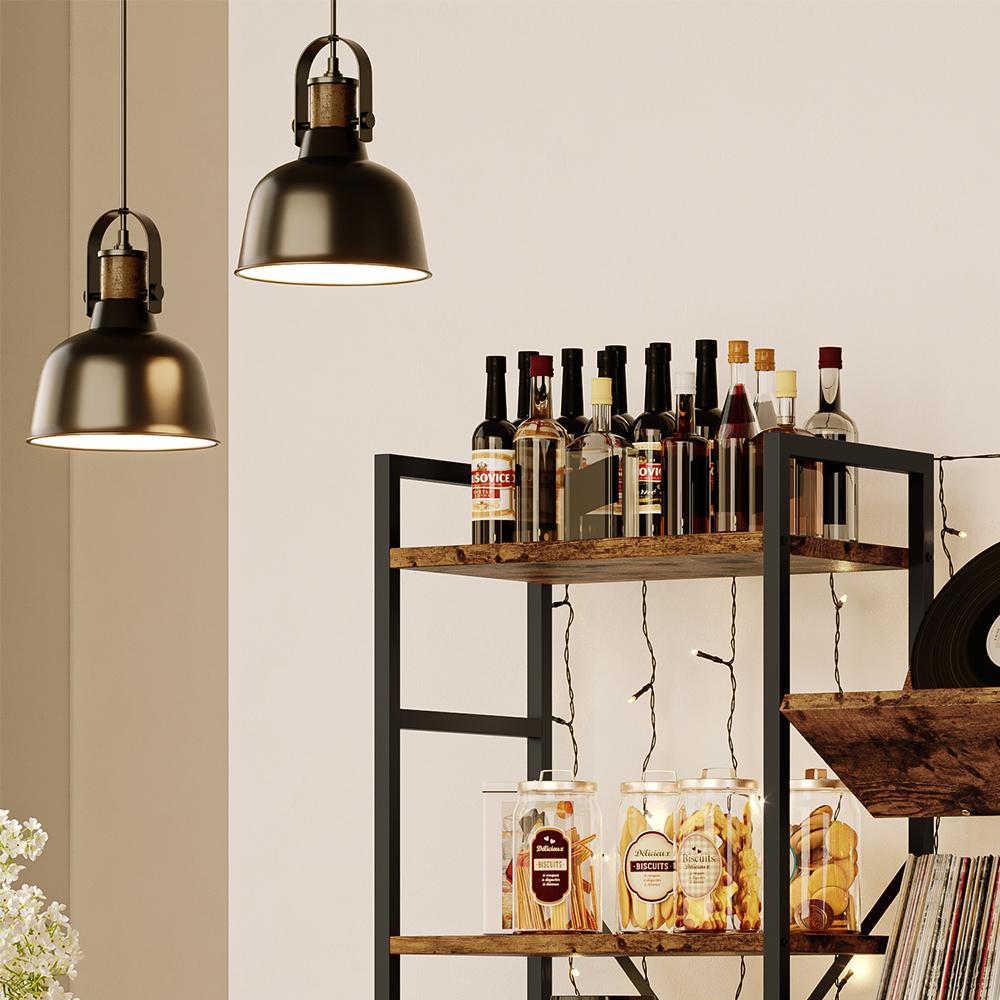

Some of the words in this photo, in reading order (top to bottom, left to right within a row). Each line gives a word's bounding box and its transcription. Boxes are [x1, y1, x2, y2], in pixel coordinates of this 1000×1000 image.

[682, 853, 716, 863] Biscuits
[538, 860, 563, 869] BISCUITS
[635, 862, 669, 870] BISCUITS
